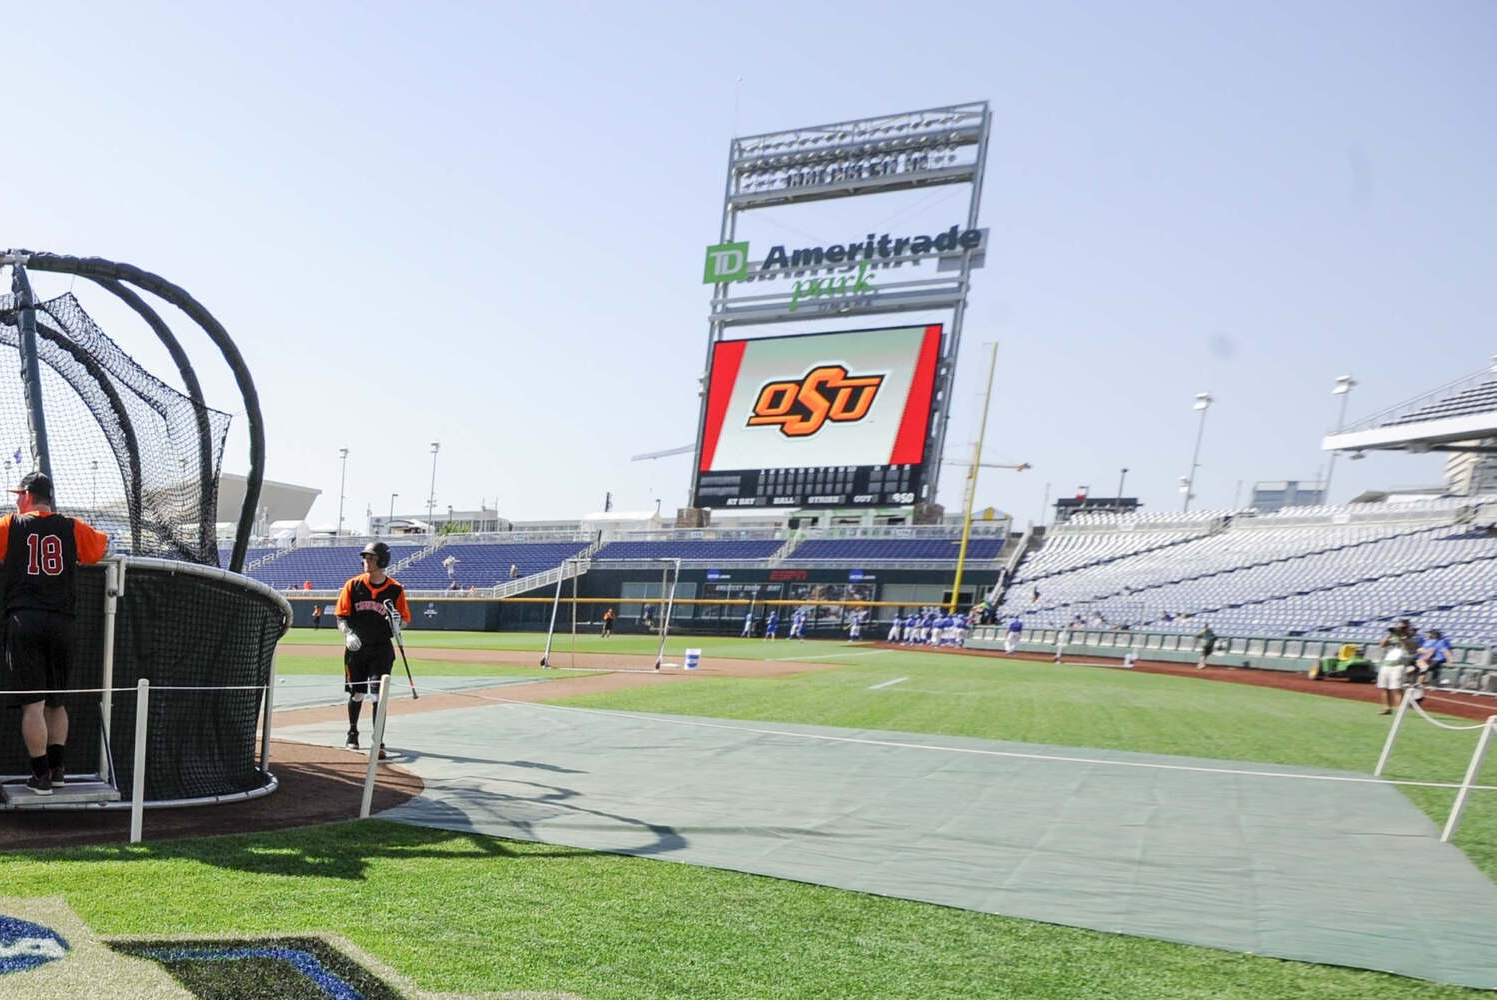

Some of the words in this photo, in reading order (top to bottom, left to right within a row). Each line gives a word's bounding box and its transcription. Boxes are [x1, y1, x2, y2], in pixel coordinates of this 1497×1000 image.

[710, 249, 744, 276] TD
[761, 224, 983, 270] Ameritrade
[788, 260, 876, 312] park
[746, 364, 886, 437] OSU
[773, 496, 795, 505] BALL
[807, 495, 840, 504] STRIKE
[853, 494, 873, 503] OUT
[27, 533, 64, 576] 18
[769, 570, 808, 581] ESPN
